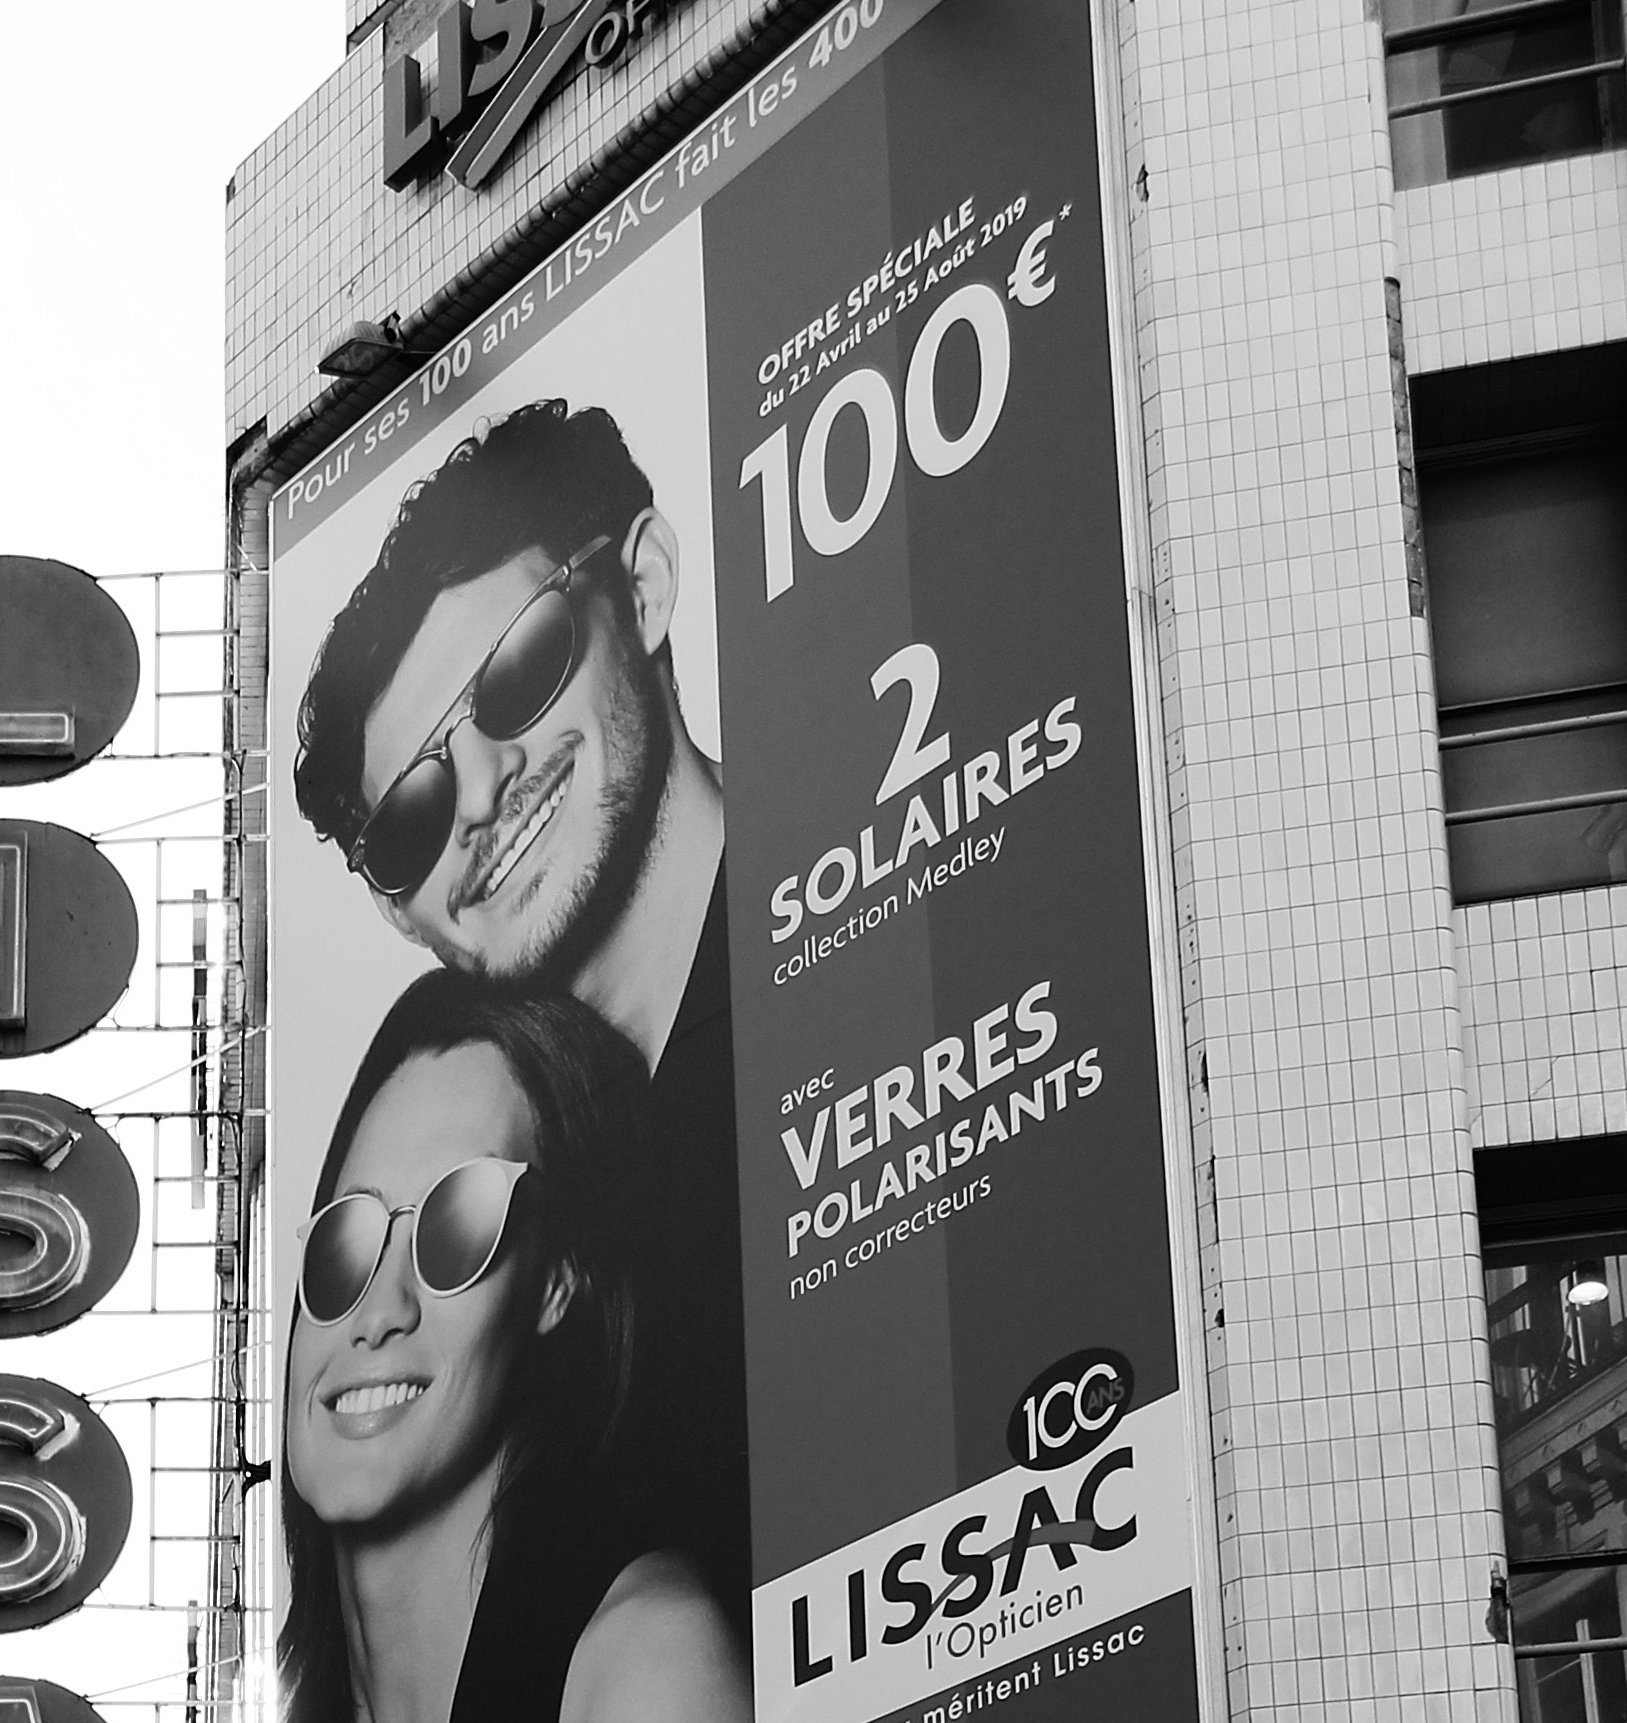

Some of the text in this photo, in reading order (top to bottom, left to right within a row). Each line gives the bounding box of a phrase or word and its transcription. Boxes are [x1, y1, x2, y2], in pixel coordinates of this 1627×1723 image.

[287, 0, 885, 519] Pour ses 100 ans LISSAC fait les 400
[757, 196, 977, 385] OFFRE SPÉCIALE
[759, 196, 1027, 418] du 22 Avril au 25 Août 2019
[870, 643, 950, 805] 2
[770, 696, 1083, 943] SOLAIRES
[773, 827, 1006, 985] collection Medley
[780, 981, 1058, 1190] VERRES
[780, 1068, 835, 1115] avec
[787, 1046, 1102, 1257] POLARISANTS
[788, 1175, 992, 1300] non correcteurs
[791, 1446, 1138, 1687] LISSAC
[926, 1583, 1084, 1670] l'Opticien
[1053, 1623, 1146, 1679] Lissac
